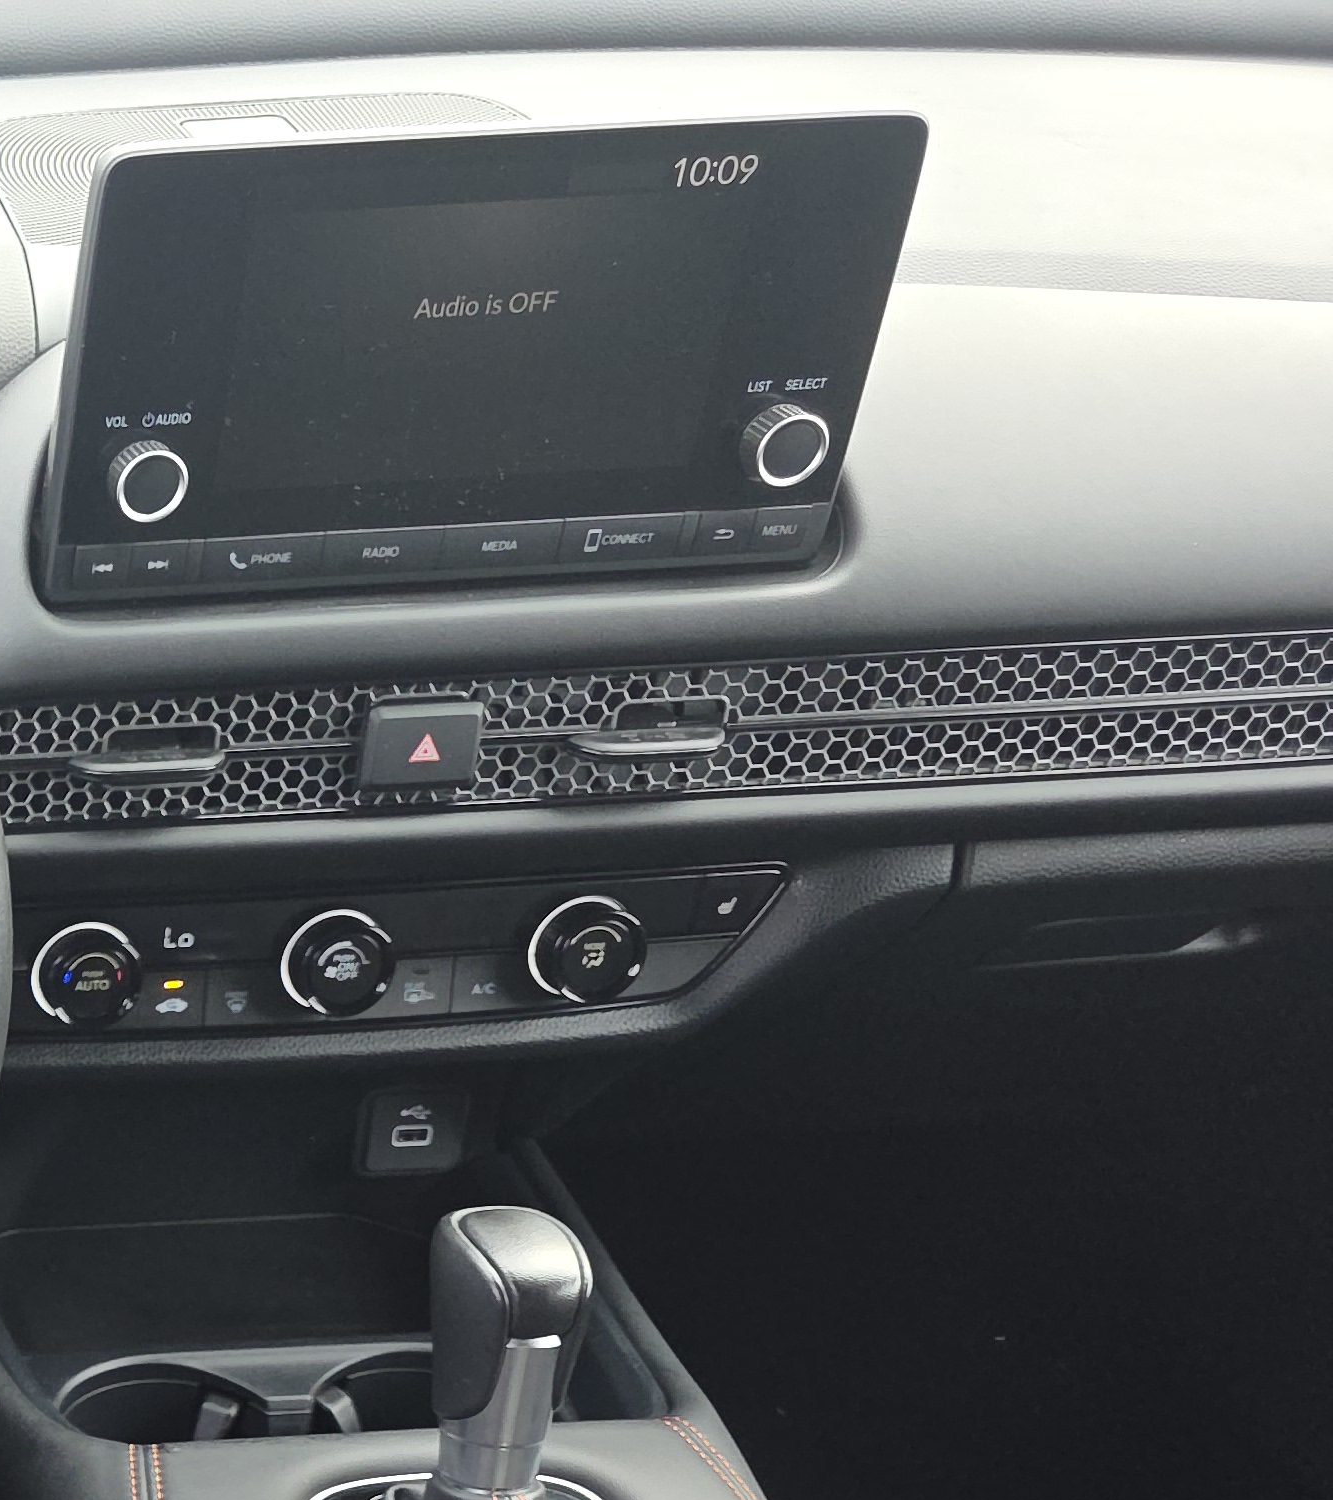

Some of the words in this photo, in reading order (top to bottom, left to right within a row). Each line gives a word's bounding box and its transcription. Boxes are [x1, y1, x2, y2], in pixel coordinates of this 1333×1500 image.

[674, 154, 759, 188] 10:09
[413, 296, 479, 319] Audio
[485, 294, 502, 315] is
[509, 291, 559, 313] OFF
[747, 379, 773, 393] LIST
[784, 377, 828, 391] SELECT
[105, 415, 128, 428] VOL
[155, 412, 192, 426] AUDIO
[761, 523, 798, 537] MENU
[481, 540, 518, 552] MEDIA
[601, 531, 655, 546] CONNECT
[250, 551, 293, 566] PHONE
[362, 546, 401, 559] RADIO
[74, 979, 110, 991] AUTO
